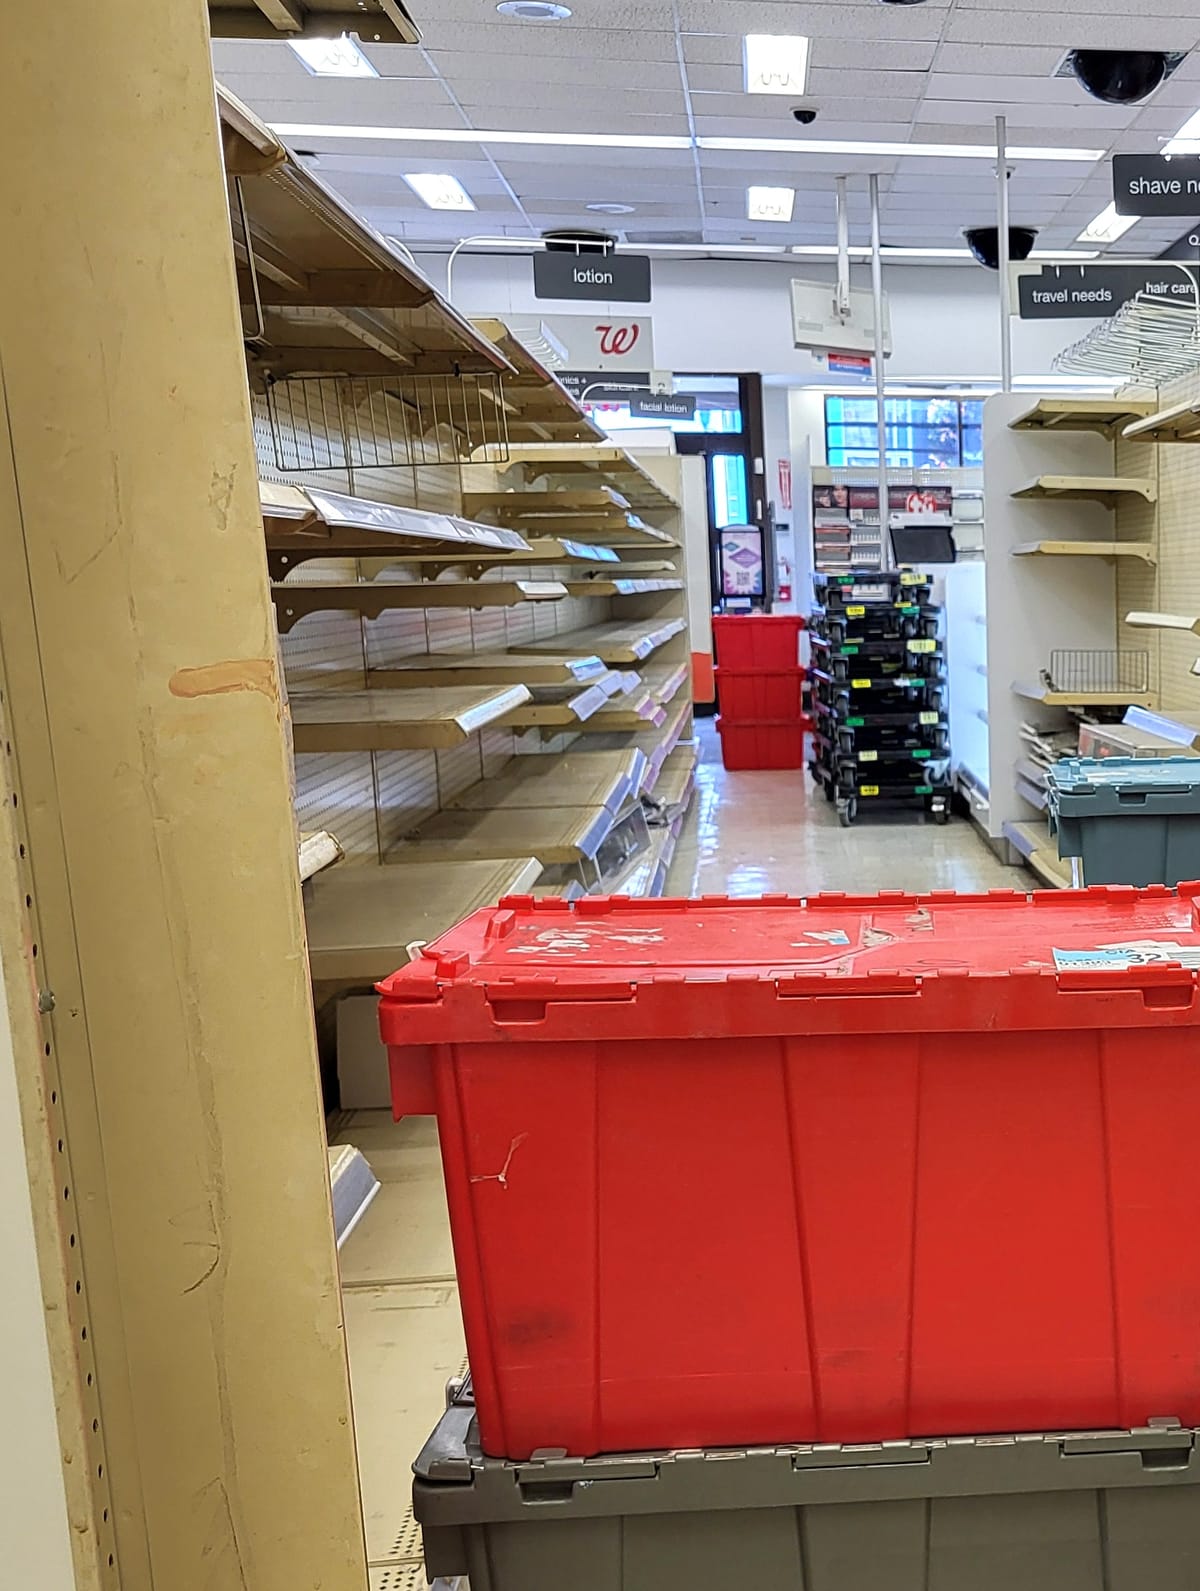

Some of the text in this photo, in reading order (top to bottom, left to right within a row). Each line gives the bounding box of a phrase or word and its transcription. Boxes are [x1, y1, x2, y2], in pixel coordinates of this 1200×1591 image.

[1128, 176, 1182, 195] shave
[572, 267, 614, 285] lotion
[1031, 287, 1113, 304] travel needs
[1145, 282, 1197, 295] hair care
[639, 400, 688, 413] facial lotion
